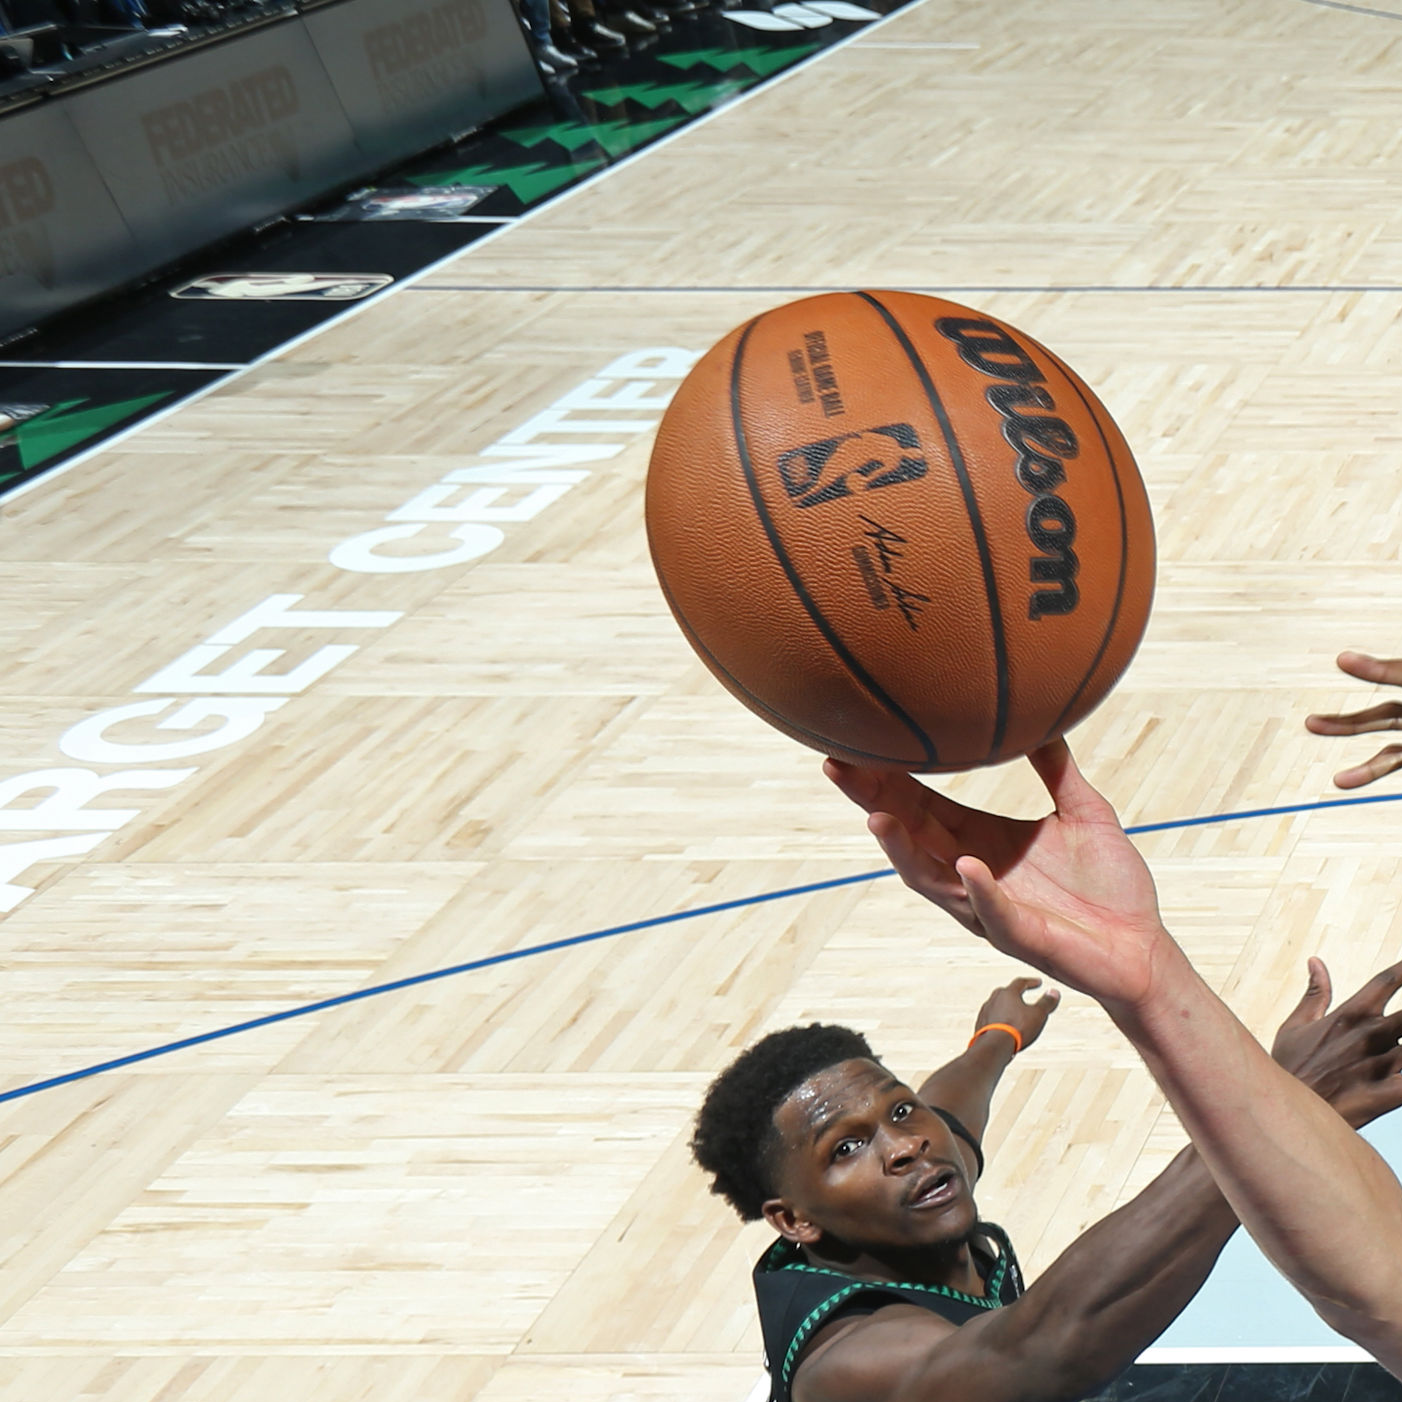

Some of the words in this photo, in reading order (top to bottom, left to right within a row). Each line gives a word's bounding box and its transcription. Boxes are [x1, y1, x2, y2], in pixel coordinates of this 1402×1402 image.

[141, 64, 299, 168] FEDERATED
[820, 391, 846, 420] BALL
[935, 315, 1083, 622] Wilson
